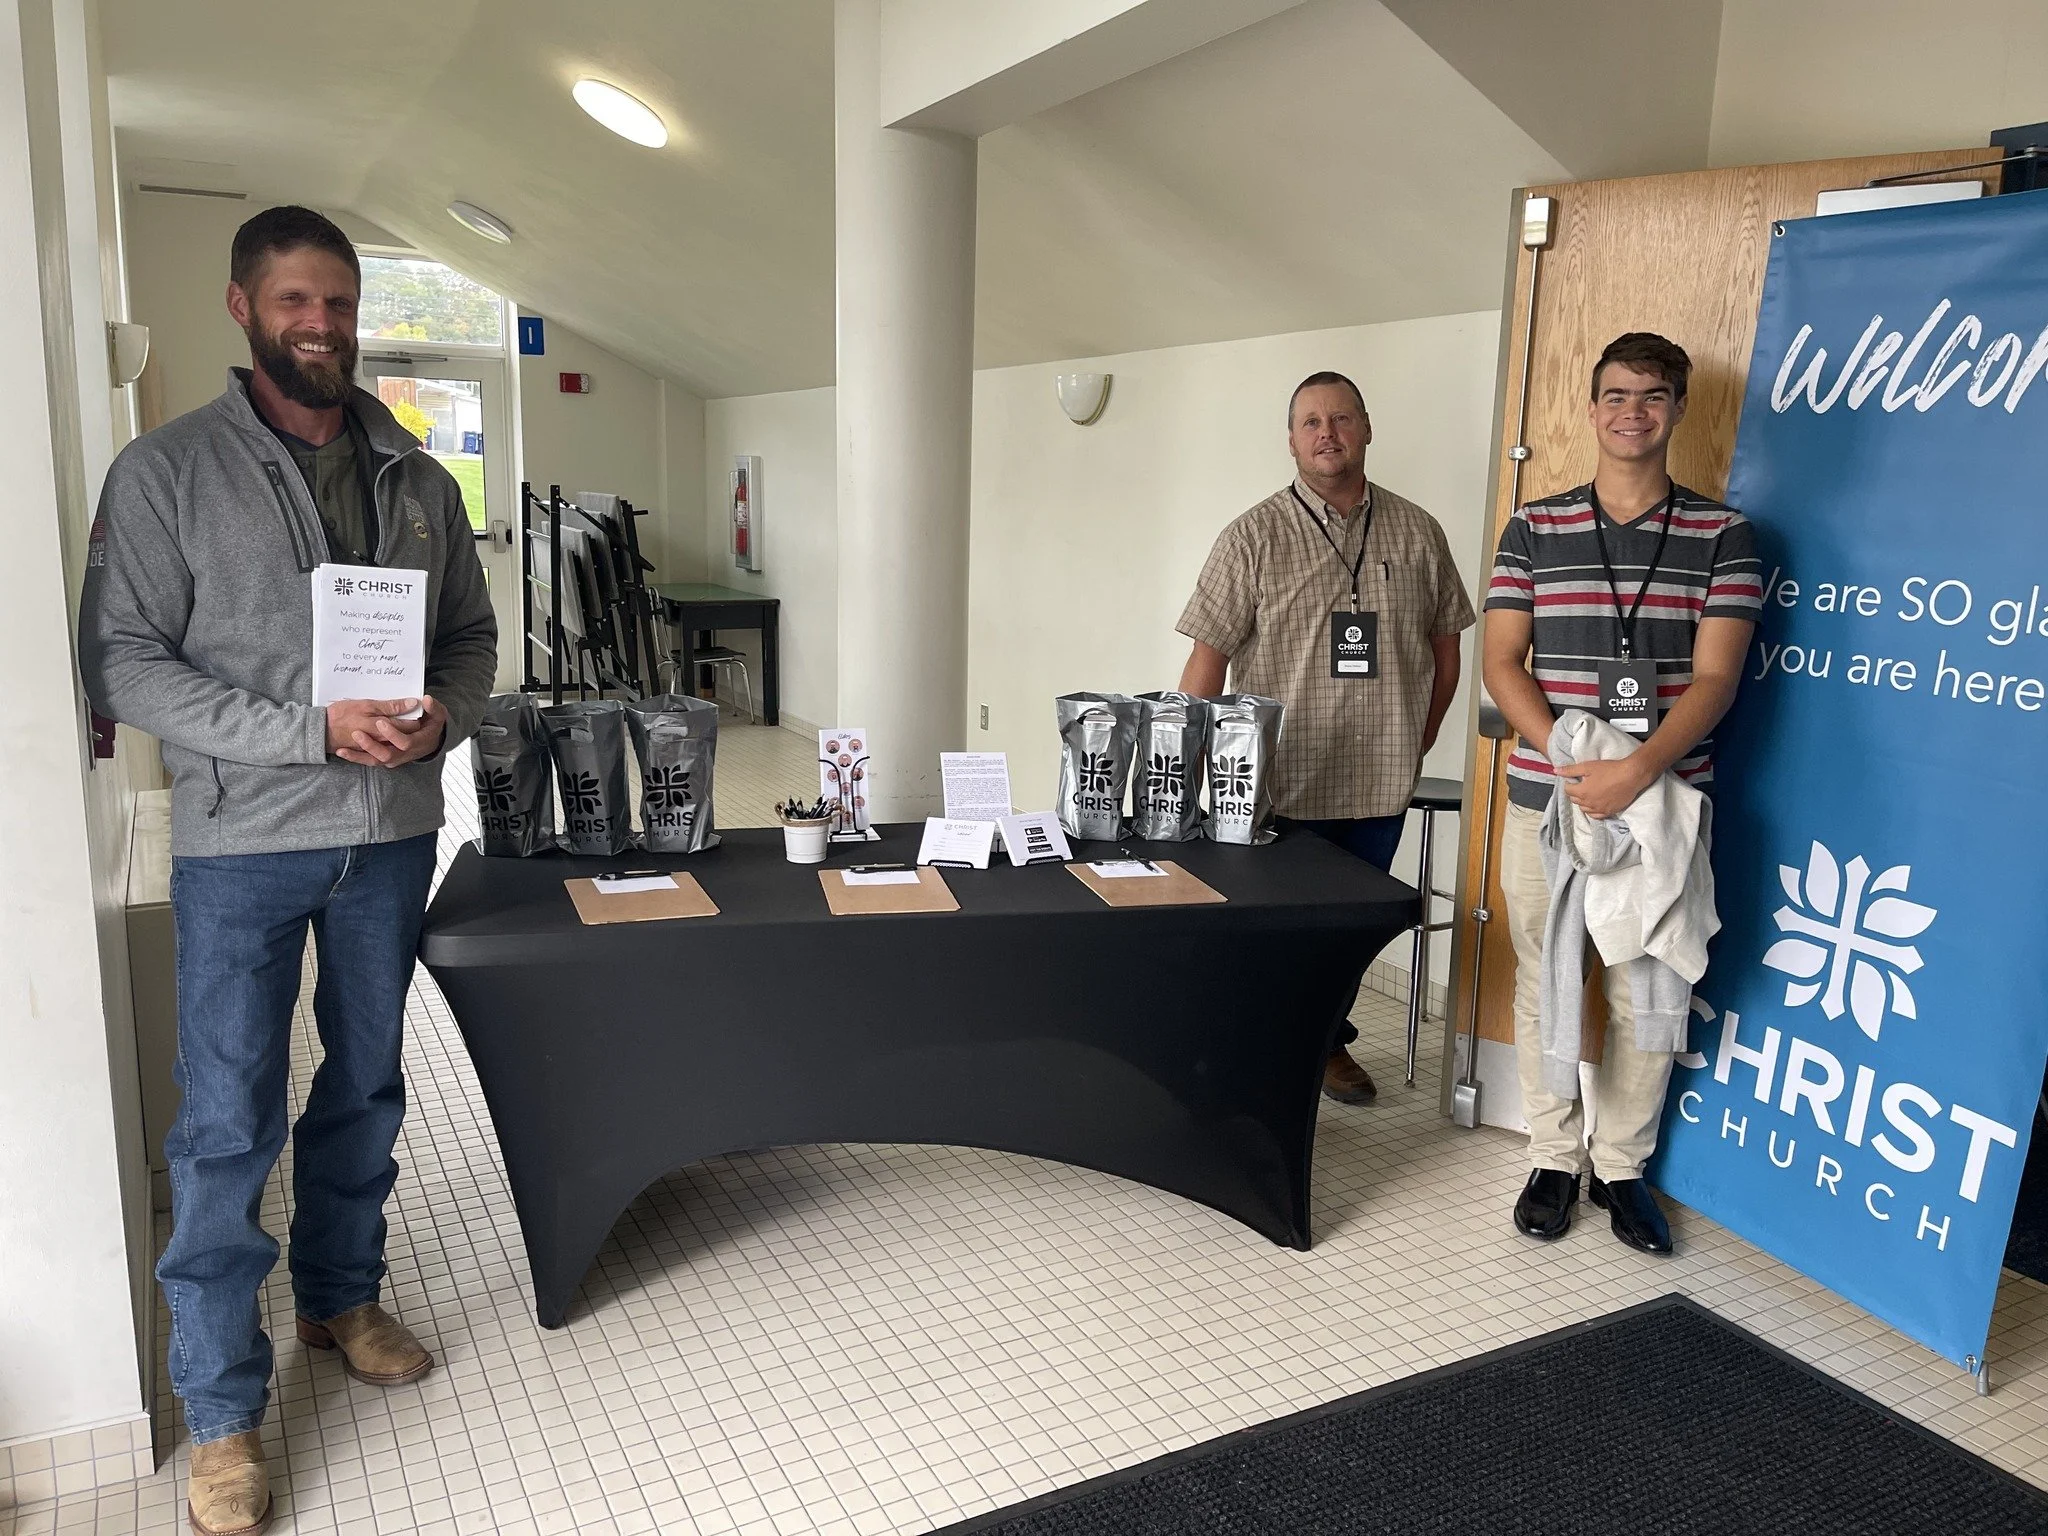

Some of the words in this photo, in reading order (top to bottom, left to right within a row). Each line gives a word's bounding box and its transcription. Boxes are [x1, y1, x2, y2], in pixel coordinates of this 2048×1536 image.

[358, 580, 413, 594] CHRIST
[1814, 583, 1882, 616] are
[1898, 576, 1972, 626] SO
[340, 610, 370, 620] Making
[372, 610, 404, 622] disciples
[341, 625, 360, 633] who
[362, 627, 402, 637] represent
[358, 638, 394, 650] Christ
[1338, 643, 1369, 651] CHRIST
[342, 652, 351, 660] to
[353, 653, 377, 663] every
[1755, 642, 1832, 680] you
[1846, 655, 1917, 691] are
[1933, 650, 2045, 711] here
[1608, 698, 1648, 707] CHRIST
[1679, 1090, 1951, 1252] CHURCH
